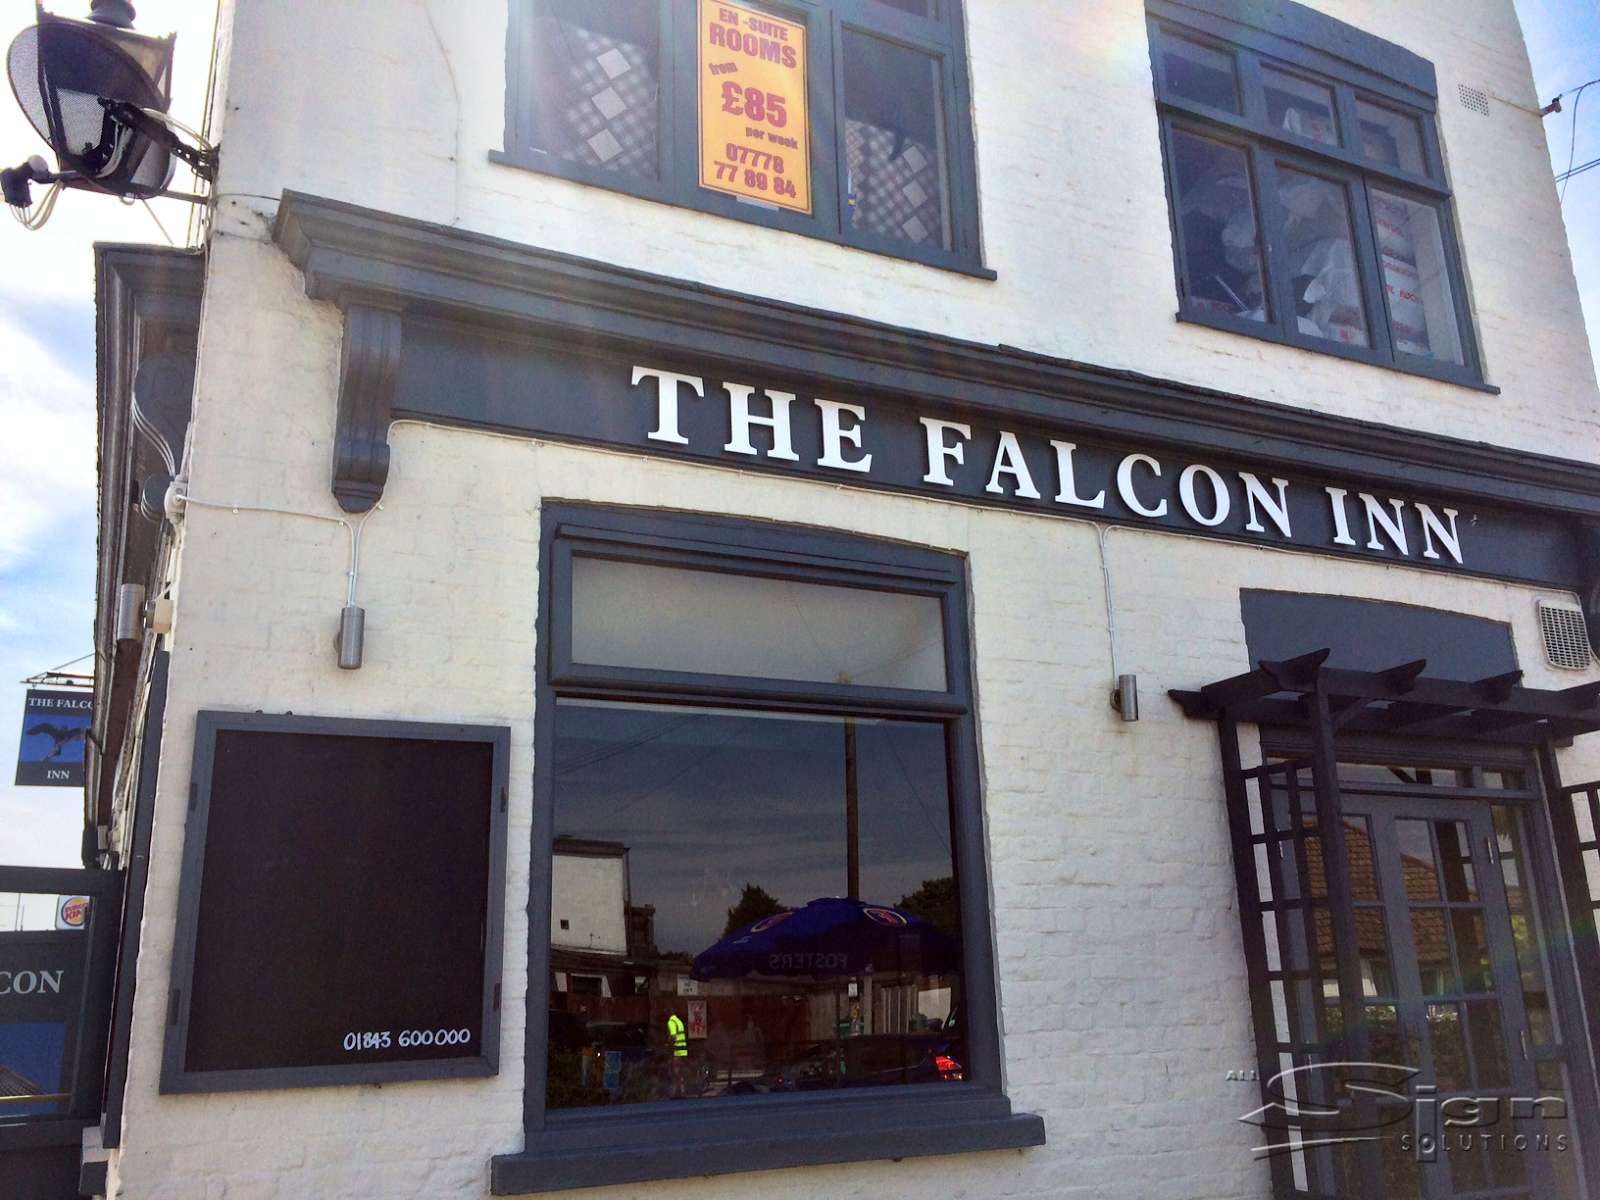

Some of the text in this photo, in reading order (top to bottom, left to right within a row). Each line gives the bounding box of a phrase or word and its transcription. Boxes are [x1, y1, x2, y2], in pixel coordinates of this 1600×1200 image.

[719, 7, 739, 26] EN
[709, 22, 797, 69] ROOMS
[708, 61, 738, 76] from
[721, 80, 787, 128] £85
[745, 126, 798, 150] per week
[726, 142, 784, 174] 07778
[714, 160, 796, 198] 77 89 84
[631, 365, 1464, 564] THE FALCON INN
[28, 697, 54, 708] THE
[46, 770, 70, 780] INN
[343, 1028, 471, 1051] 01843 600000
